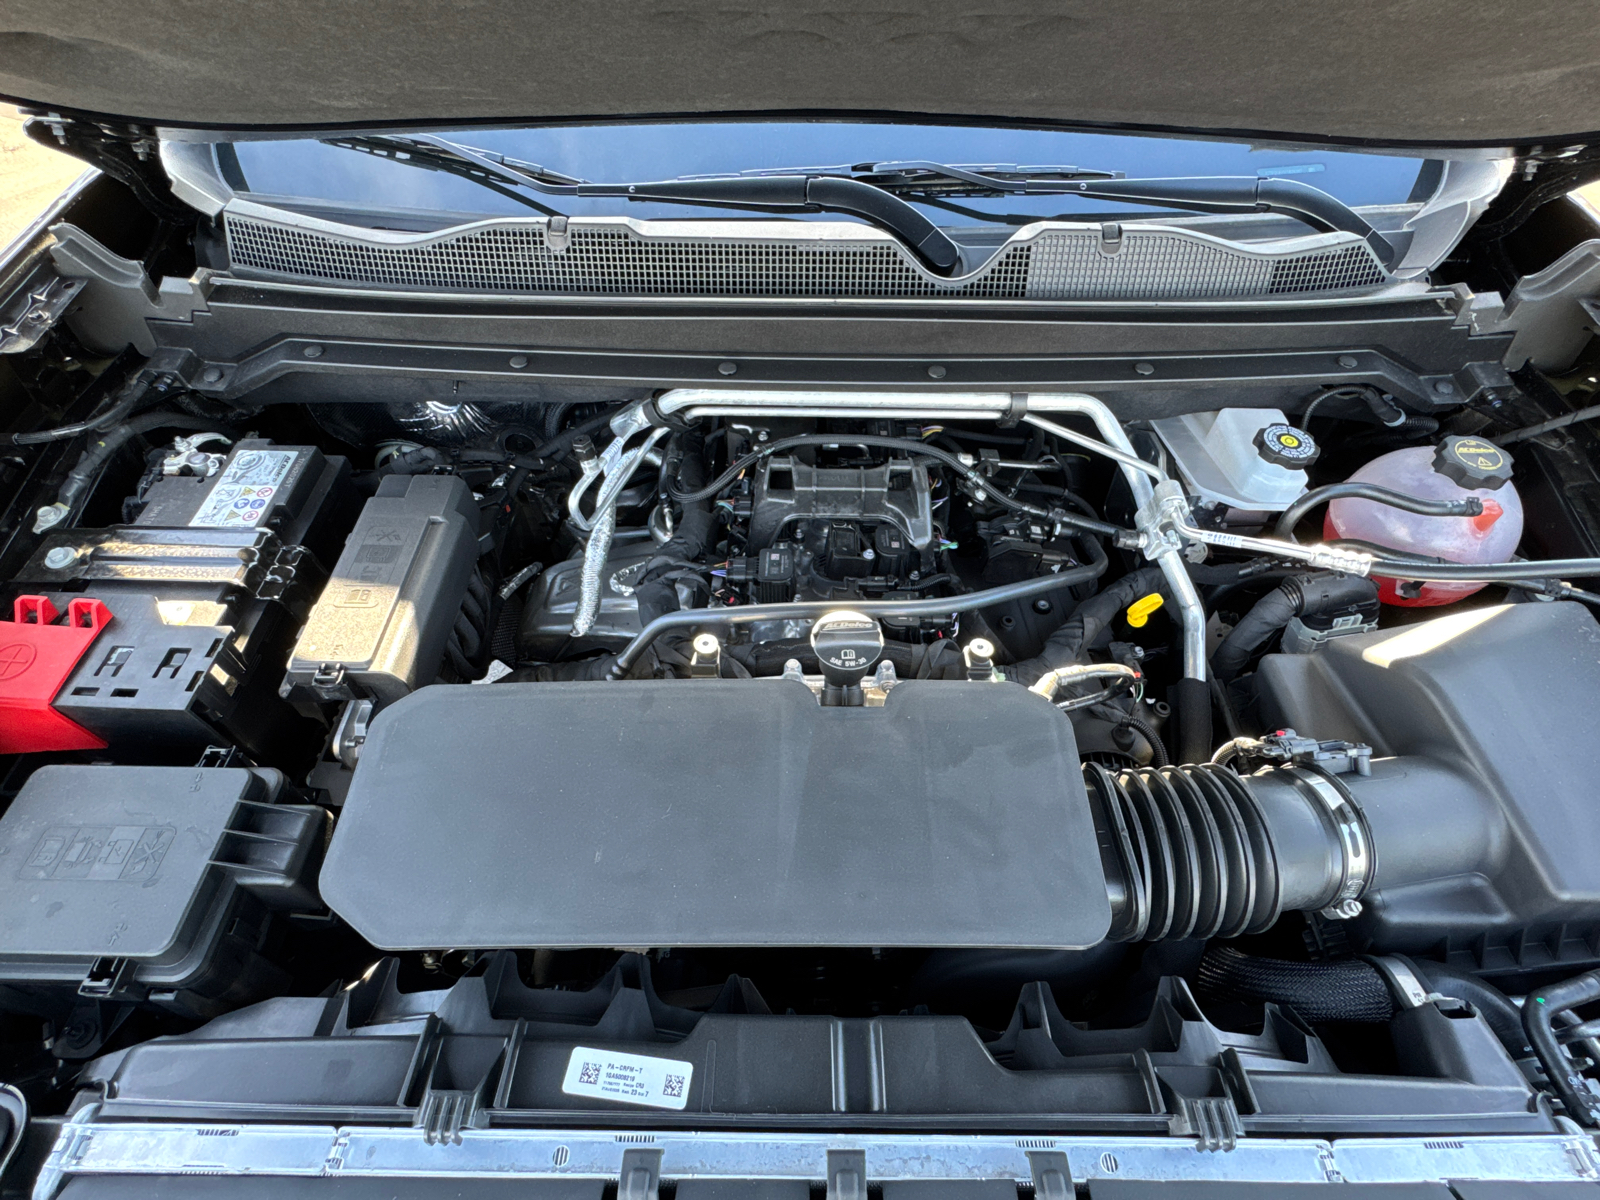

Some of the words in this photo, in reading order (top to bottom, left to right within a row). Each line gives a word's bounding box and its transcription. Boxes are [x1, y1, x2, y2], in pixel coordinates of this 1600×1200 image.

[272, 454, 291, 483] ACDelco
[825, 621, 873, 629] ACDelco
[830, 656, 843, 667] SAE
[845, 656, 867, 667] 5W-30
